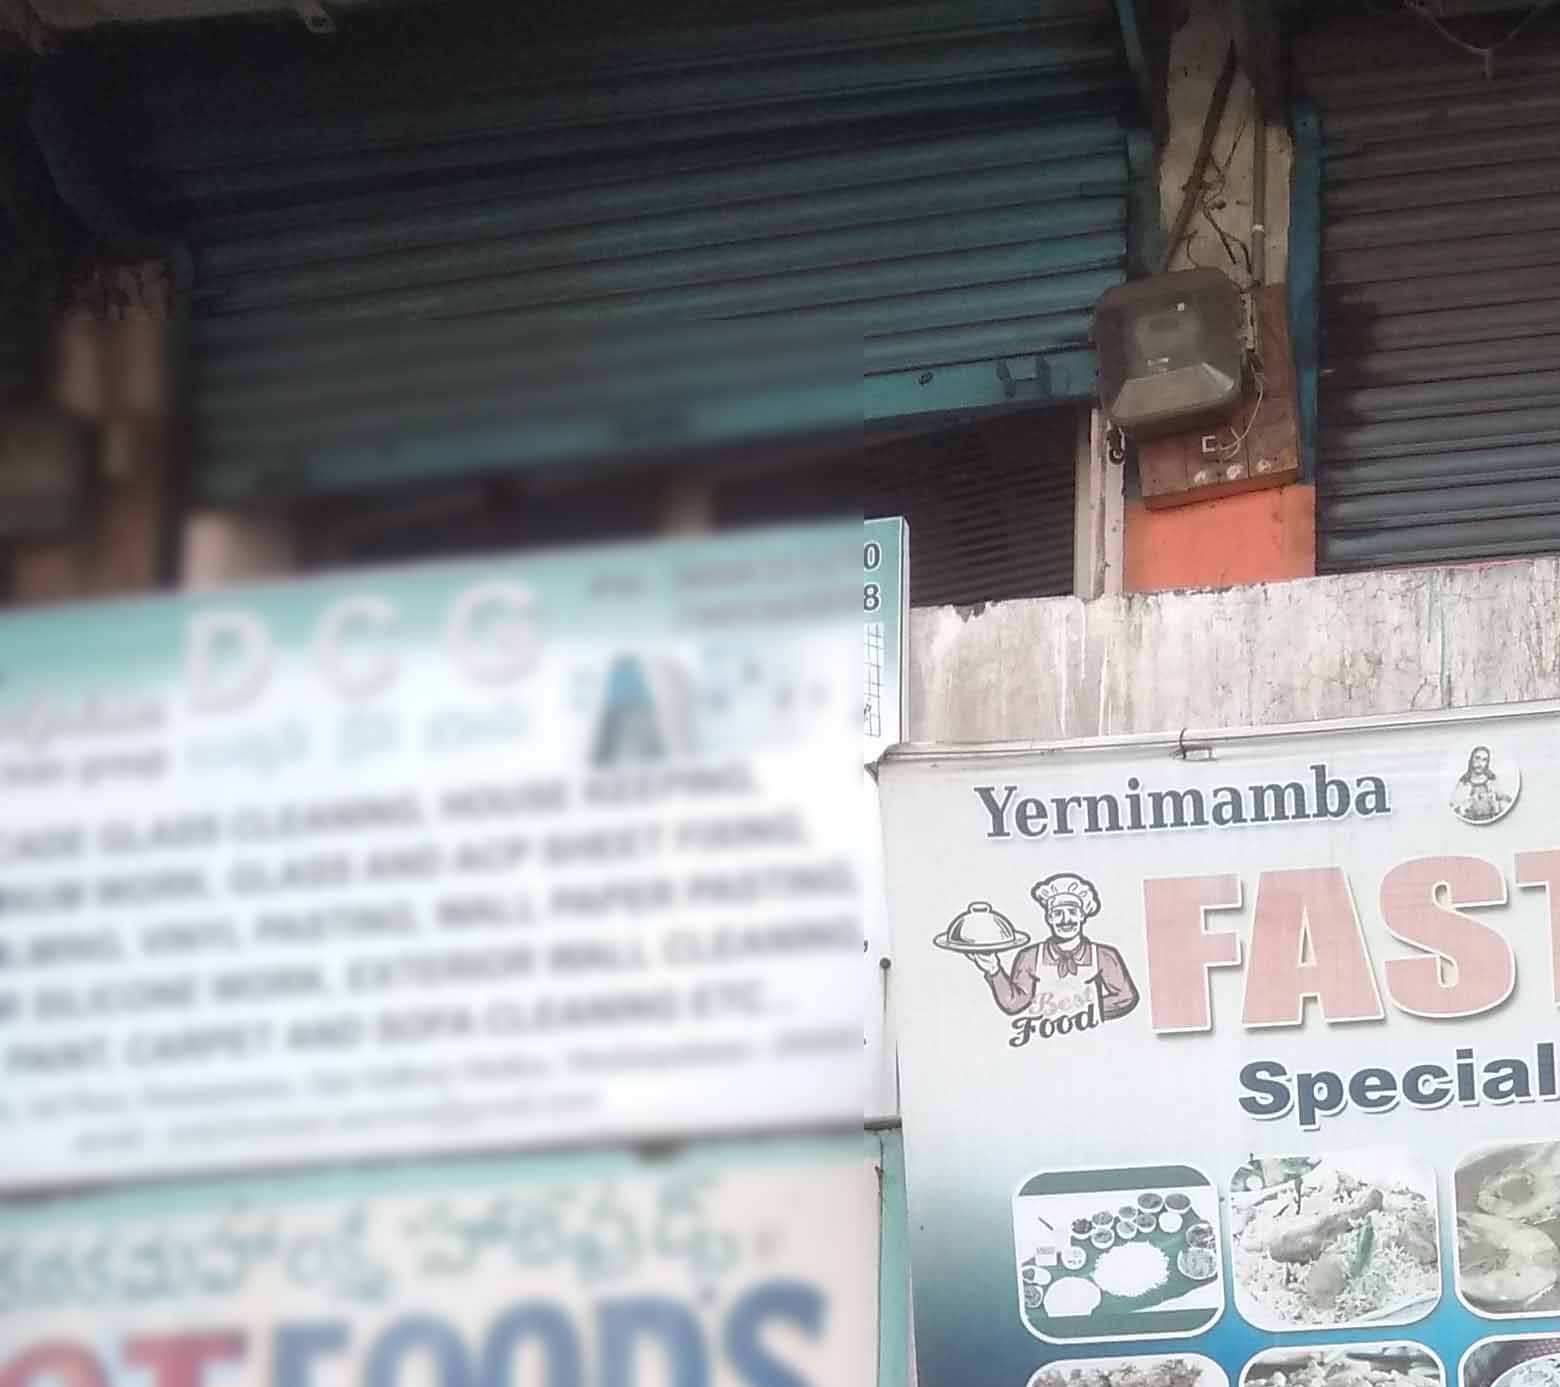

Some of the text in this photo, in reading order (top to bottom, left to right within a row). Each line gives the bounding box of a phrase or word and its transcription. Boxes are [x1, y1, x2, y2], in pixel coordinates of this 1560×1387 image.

[974, 764, 1392, 840] Yernimamba
[1008, 1003, 1099, 1047] Food
[1238, 1043, 1558, 1130] Special
